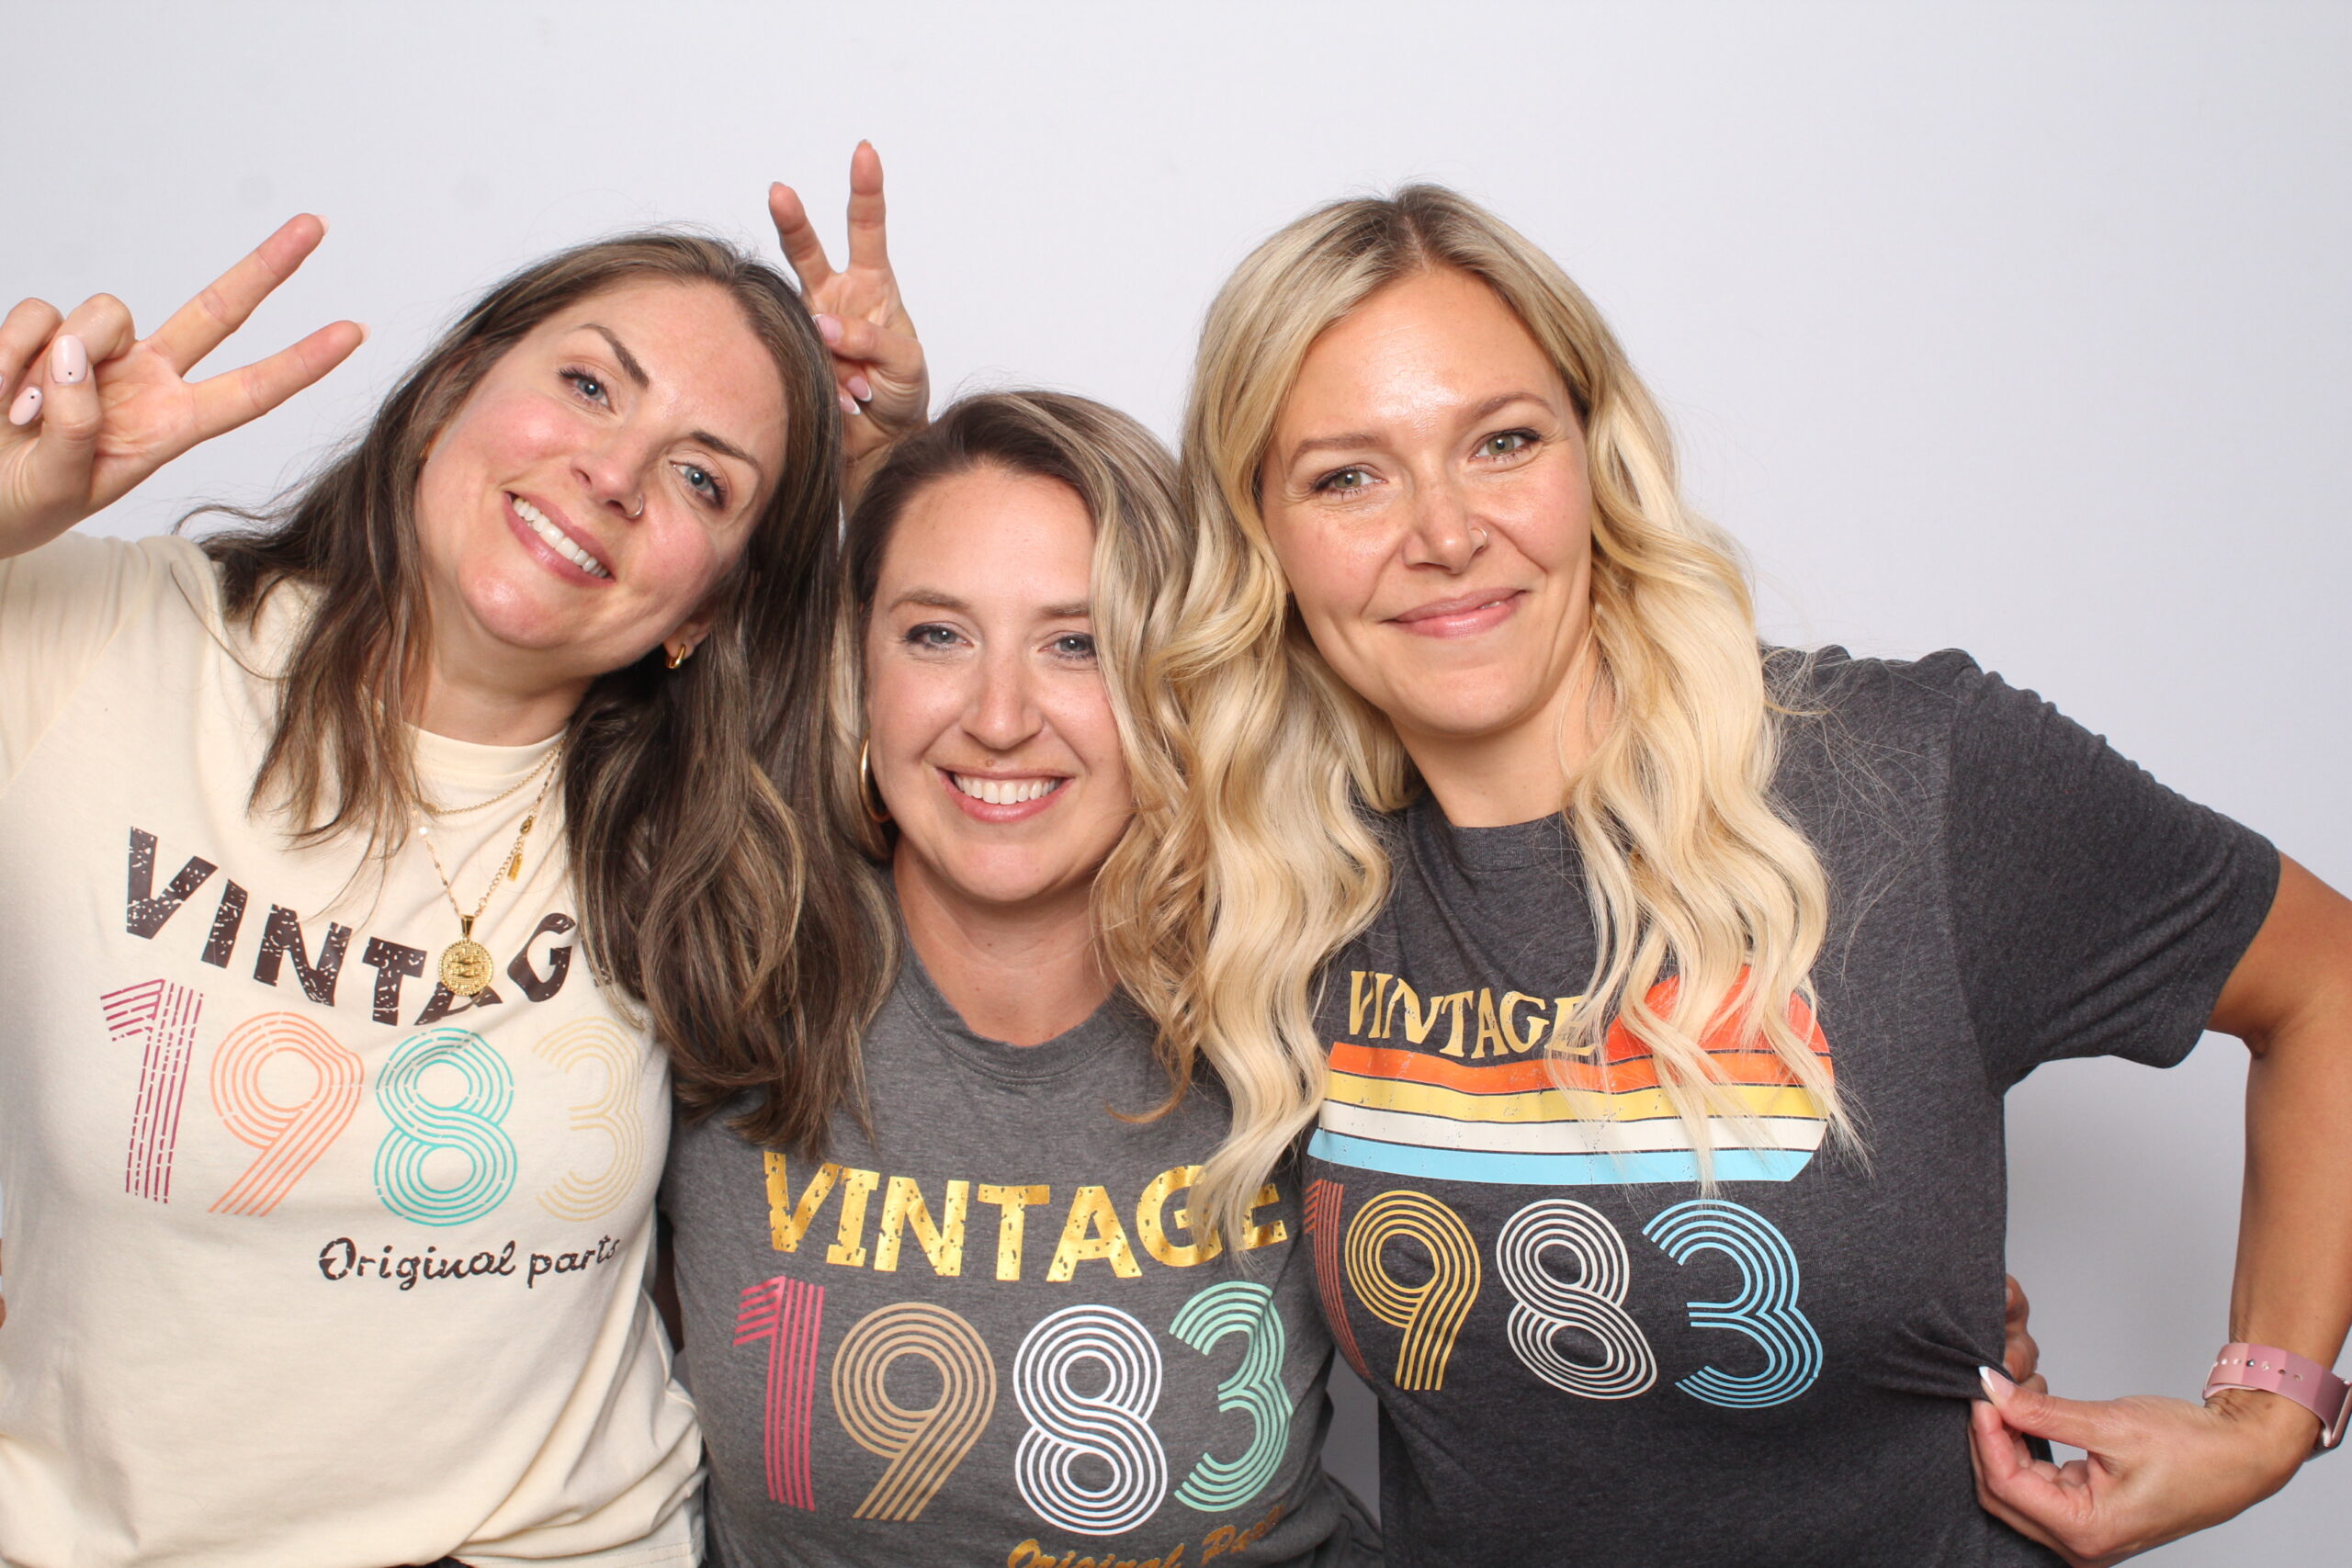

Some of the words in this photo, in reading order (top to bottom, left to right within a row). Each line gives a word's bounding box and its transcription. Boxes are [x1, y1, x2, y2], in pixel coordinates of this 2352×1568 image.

[126, 826, 614, 1026] VINTAG
[1349, 970, 1598, 1059] VINTAGE
[100, 978, 646, 1226] 1983
[319, 1237, 515, 1291] Original
[527, 1235, 620, 1288] parts
[1304, 1179, 1824, 1408] 1983
[733, 1275, 1294, 1535] 1983
